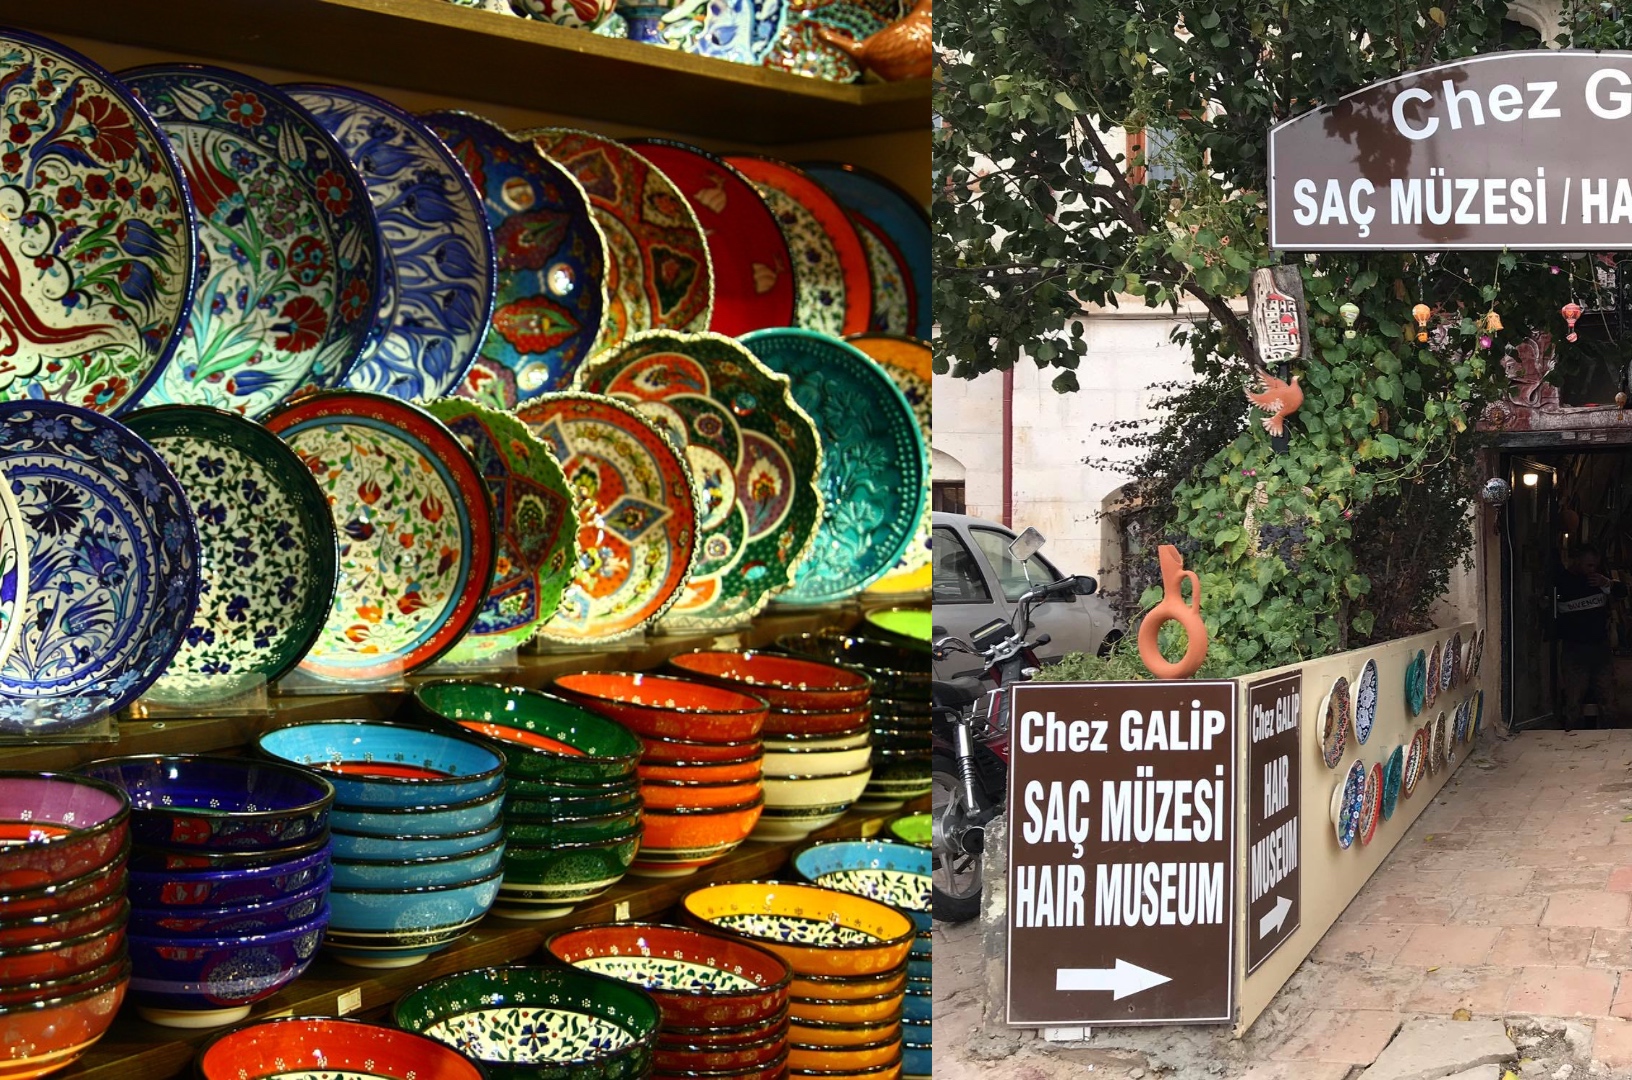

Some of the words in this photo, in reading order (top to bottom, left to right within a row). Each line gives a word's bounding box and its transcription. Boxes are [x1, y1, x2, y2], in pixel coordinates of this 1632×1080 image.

[1392, 79, 1562, 141] Chez
[1292, 177, 1376, 238] SAÇ
[1390, 166, 1547, 225] MÜZESİ
[1561, 176, 1572, 225] /
[1020, 711, 1109, 753] Chez
[1119, 699, 1226, 752] GALİP
[1252, 703, 1275, 743] Chez
[1276, 686, 1300, 734] GALİP
[1022, 779, 1090, 859] SAÇ
[1101, 764, 1224, 843] MÜZESİ
[1264, 754, 1289, 819] HAIR
[1251, 816, 1298, 903] MUSEUM
[1015, 864, 1086, 928] HAIR
[1094, 861, 1224, 927] MUSEUM
